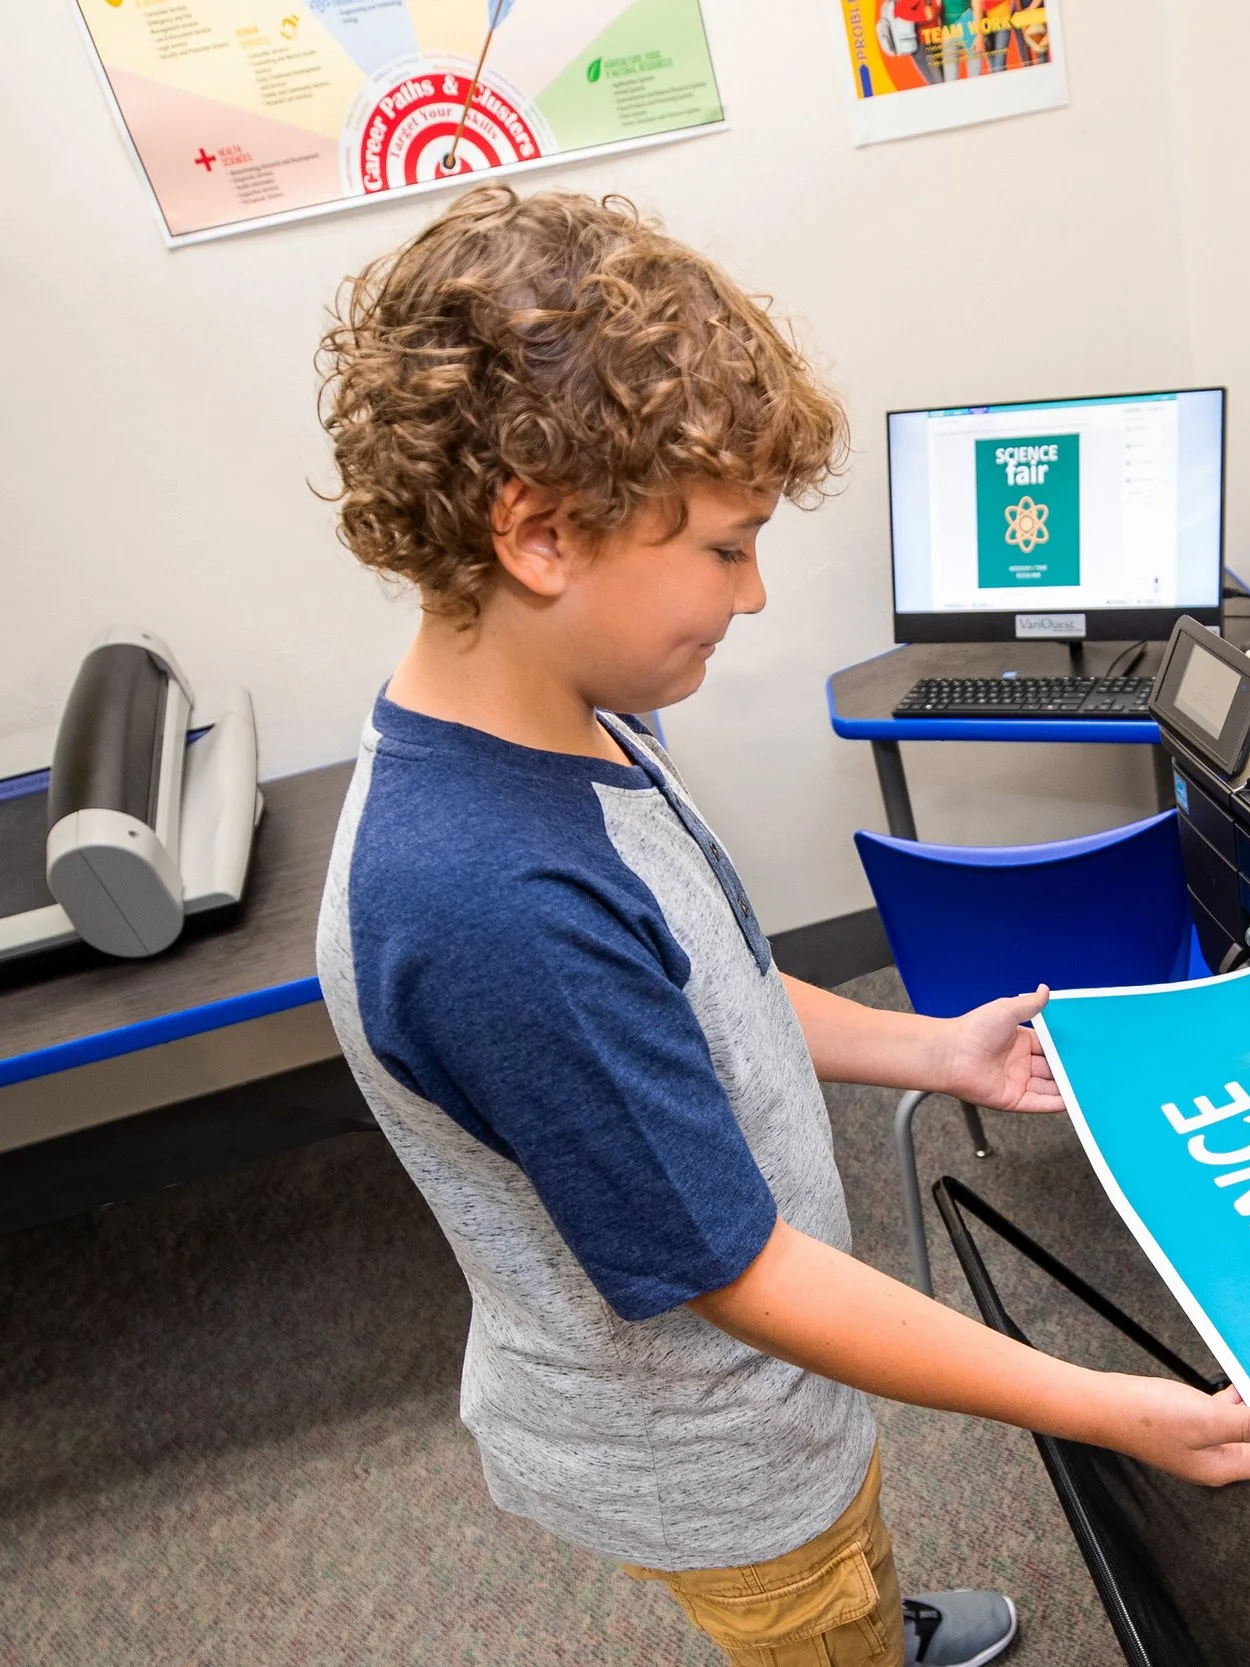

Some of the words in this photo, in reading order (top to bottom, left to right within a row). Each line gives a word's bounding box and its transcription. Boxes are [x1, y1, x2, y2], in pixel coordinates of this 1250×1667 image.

[849, 0, 867, 61] PROBL
[921, 24, 963, 45] TEAM
[364, 115, 388, 191] Career
[379, 79, 435, 120] Paths
[442, 73, 459, 95] &
[471, 82, 535, 157] Clusters
[391, 118, 419, 158] Target
[420, 108, 452, 121] Your
[995, 444, 1059, 465] SCIENCE
[1005, 459, 1049, 487] fair
